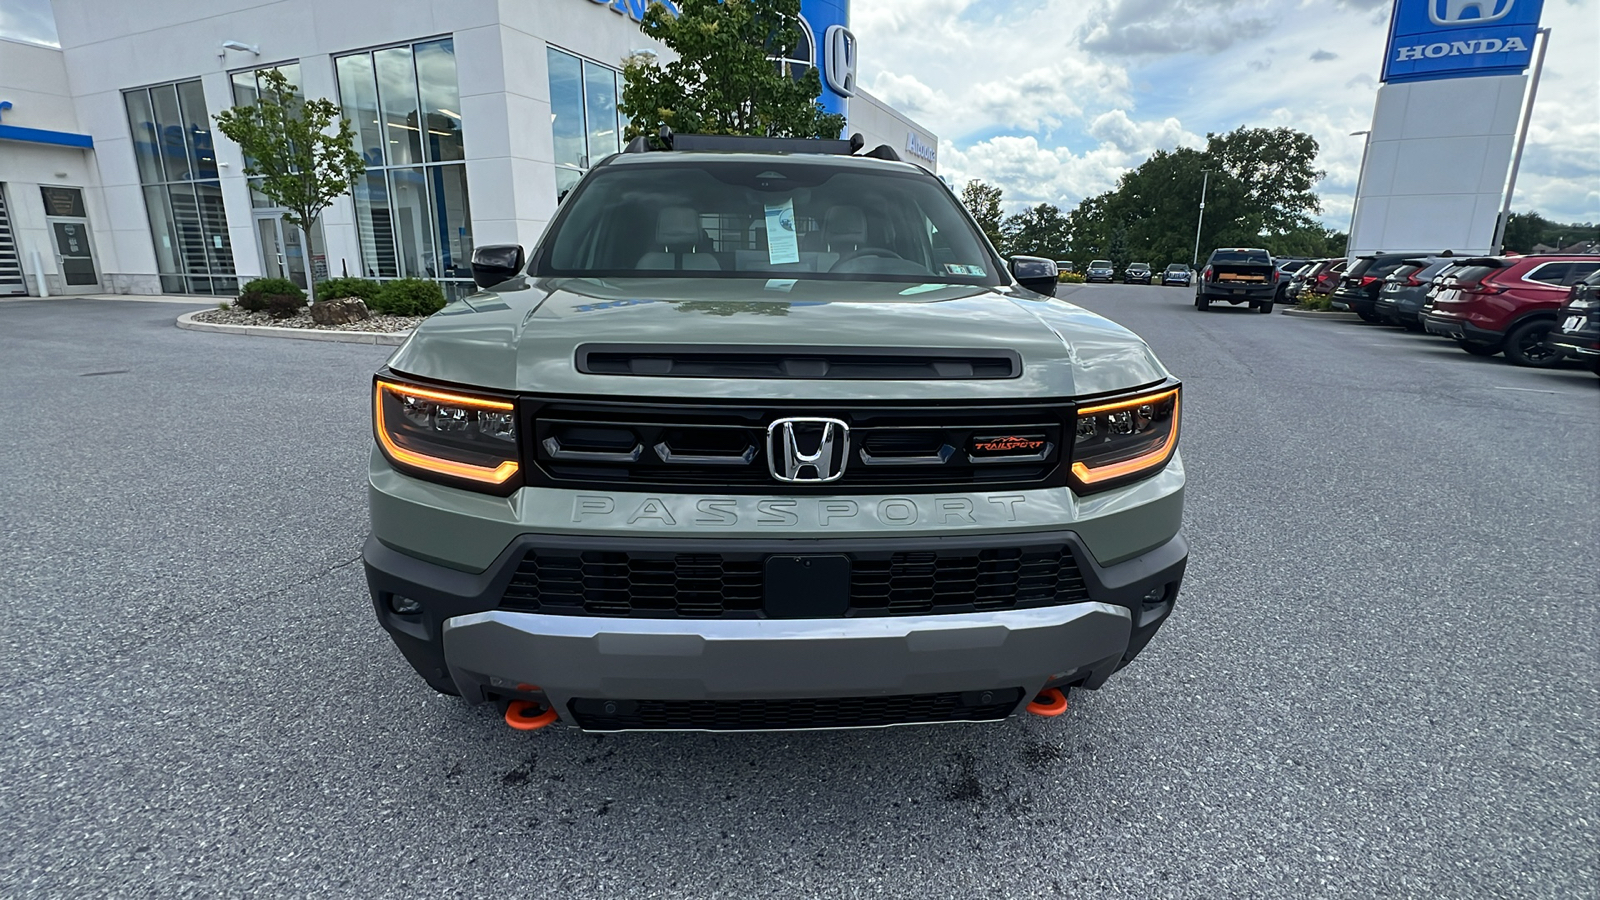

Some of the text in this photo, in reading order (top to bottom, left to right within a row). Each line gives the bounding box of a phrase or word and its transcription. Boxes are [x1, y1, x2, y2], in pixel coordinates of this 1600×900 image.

[1396, 37, 1528, 61] HONDA
[975, 441, 1044, 450] TRAILSPORT
[572, 495, 1026, 526] PASSPORT
